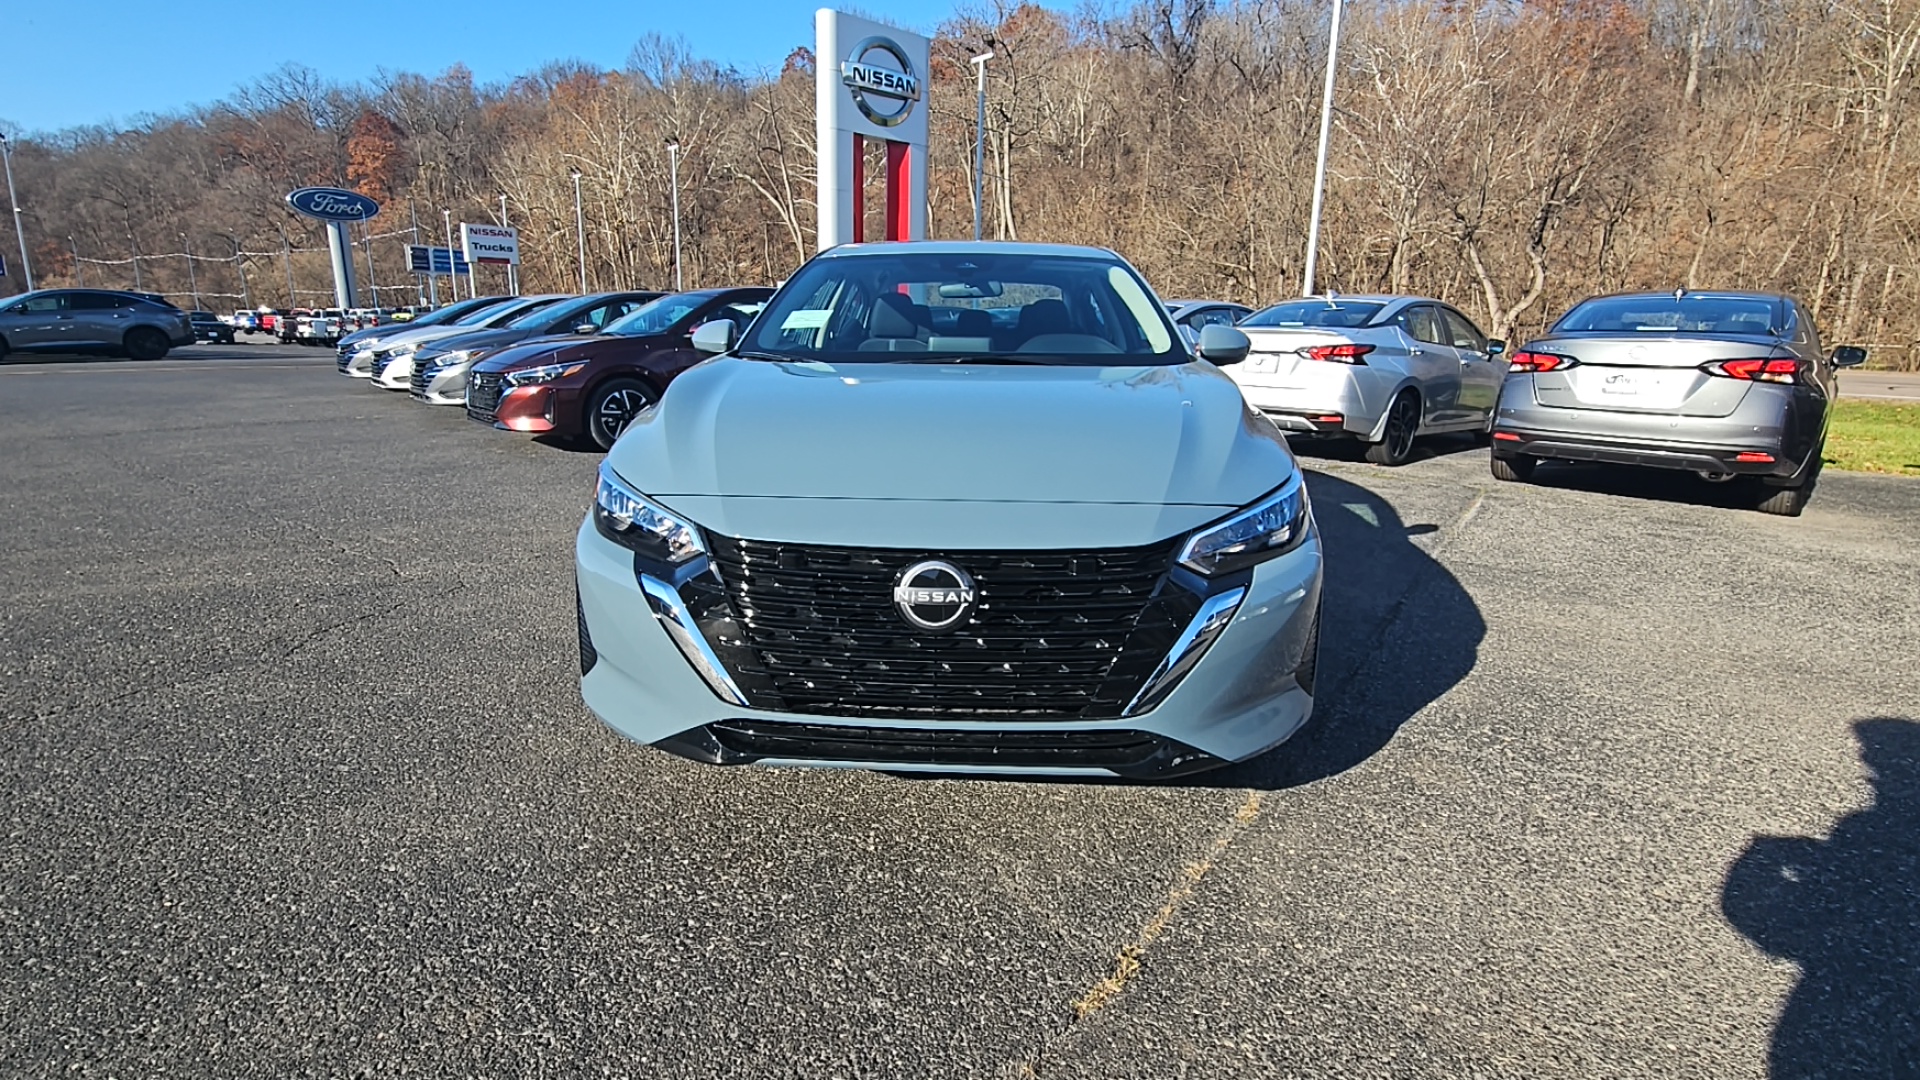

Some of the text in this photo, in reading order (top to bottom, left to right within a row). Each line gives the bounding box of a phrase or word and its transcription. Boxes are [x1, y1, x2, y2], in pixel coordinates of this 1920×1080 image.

[852, 66, 916, 95] NISSAN
[310, 193, 363, 215] Ford
[469, 227, 513, 238] NISSAN
[471, 242, 514, 253] Trucks
[897, 590, 974, 603] NISSAN
